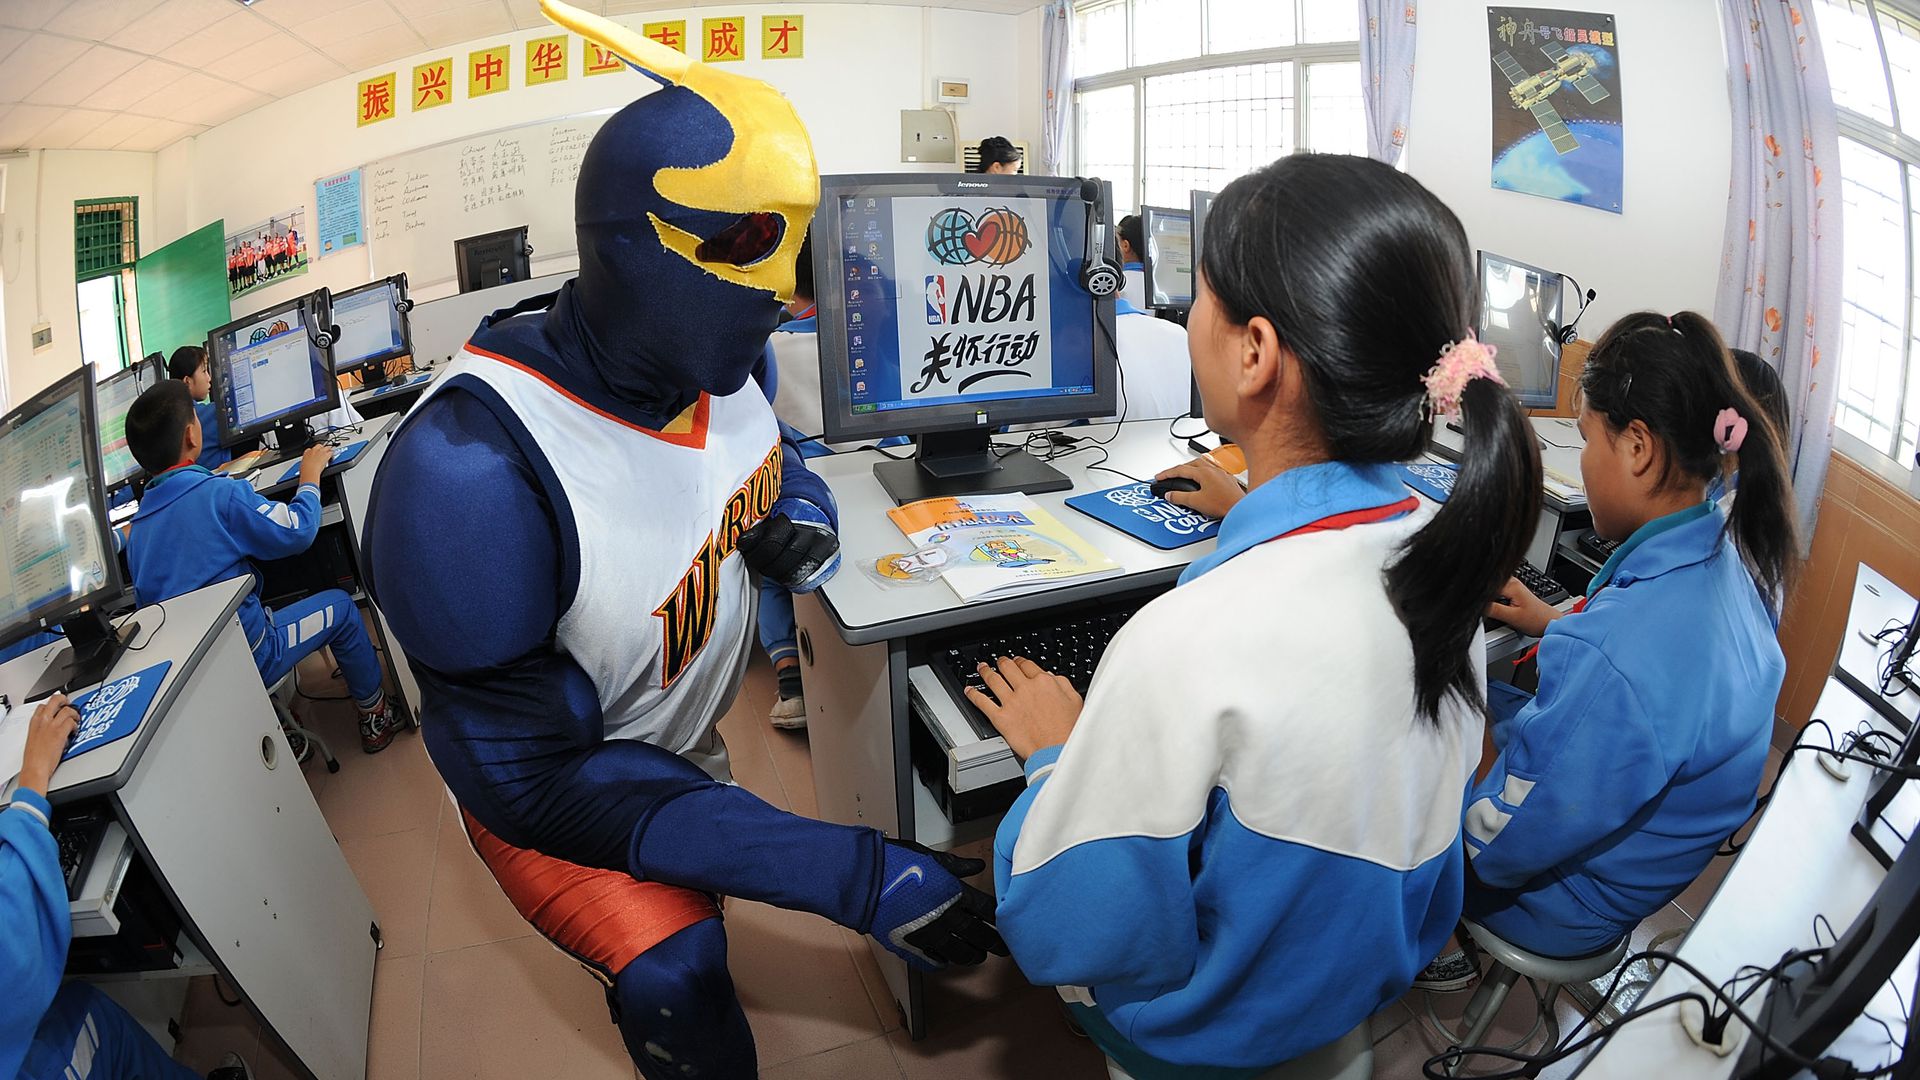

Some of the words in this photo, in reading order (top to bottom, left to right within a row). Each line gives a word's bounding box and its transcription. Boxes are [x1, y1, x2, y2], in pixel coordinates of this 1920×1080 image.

[928, 315, 941, 323] NBA
[951, 273, 1036, 325] NBA
[910, 330, 1040, 393] 关怀行动
[80, 698, 127, 730] NBA
